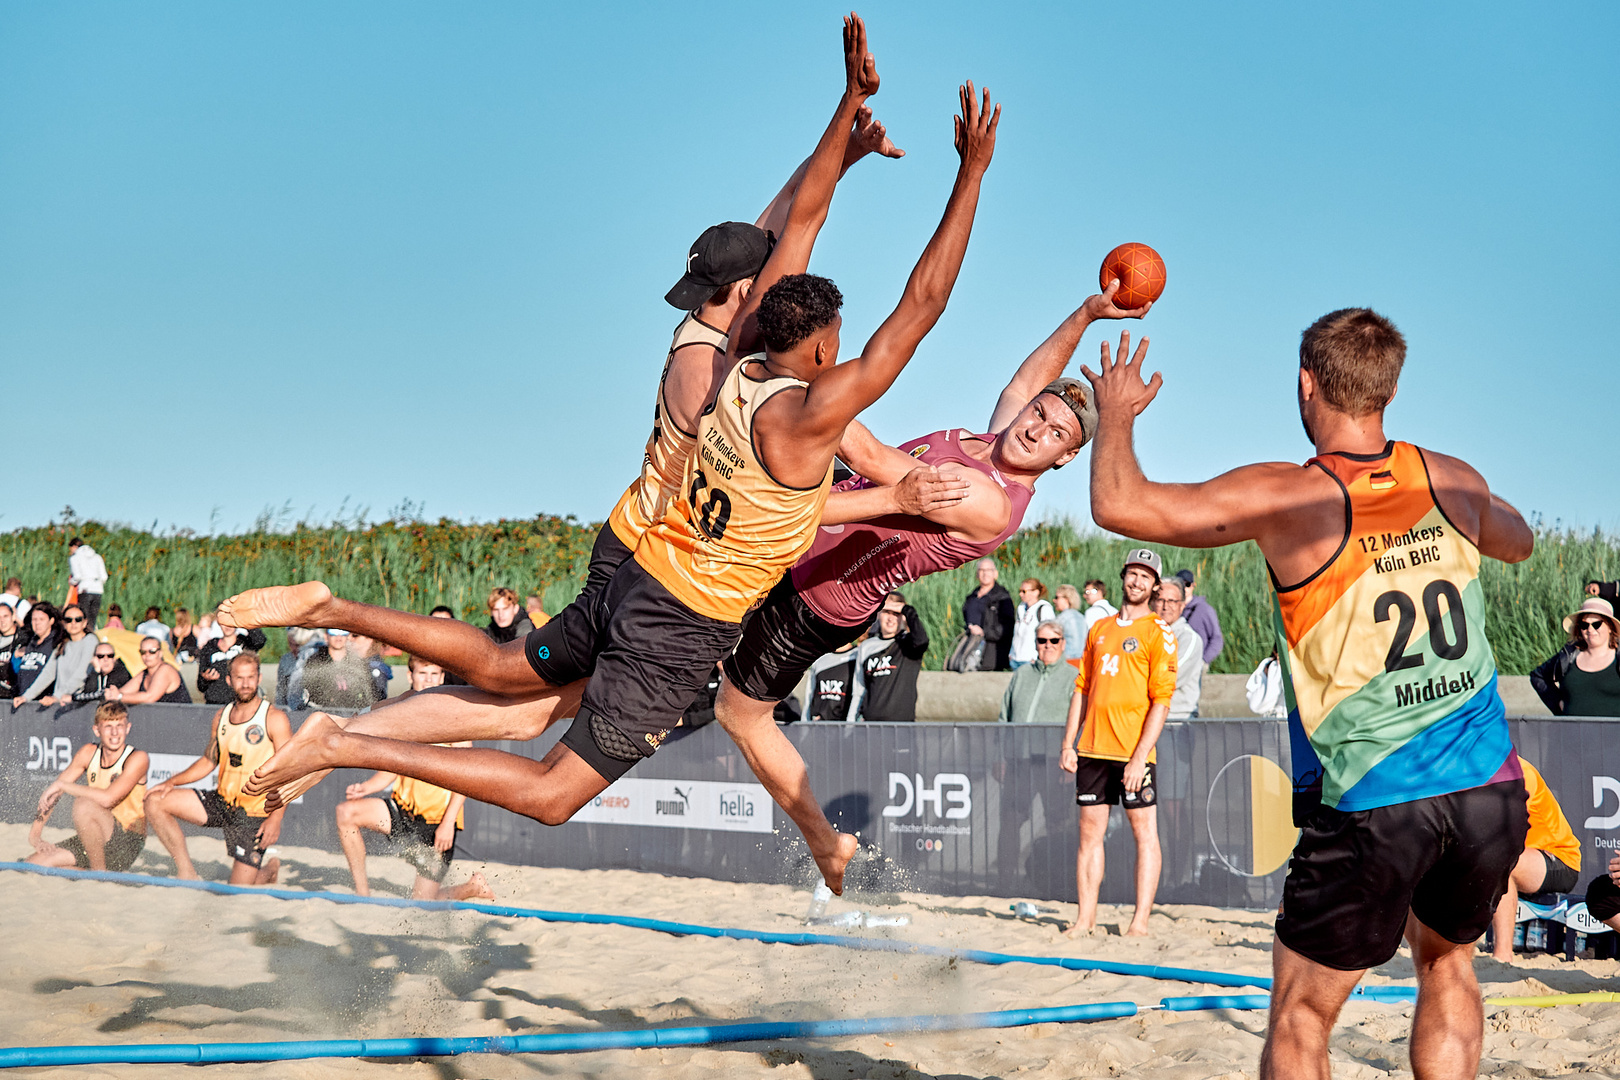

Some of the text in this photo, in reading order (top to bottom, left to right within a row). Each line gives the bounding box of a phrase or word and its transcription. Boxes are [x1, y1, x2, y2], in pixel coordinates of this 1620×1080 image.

[701, 444, 733, 480] Köln BHC
[705, 427, 746, 469] 12 Monkeys
[1359, 525, 1444, 553] 12 Monkeys
[1374, 546, 1440, 574] Köln BHC
[1373, 579, 1468, 673] 20
[1101, 653, 1119, 677] 14
[1394, 670, 1475, 707] Middell
[221, 725, 227, 736] 5
[26, 735, 73, 771] DHB
[90, 772, 97, 783] 8
[655, 800, 684, 816] PUMA
[719, 793, 754, 817] hella
[882, 772, 972, 819] DHB
[1594, 836, 1620, 848] Deuts
